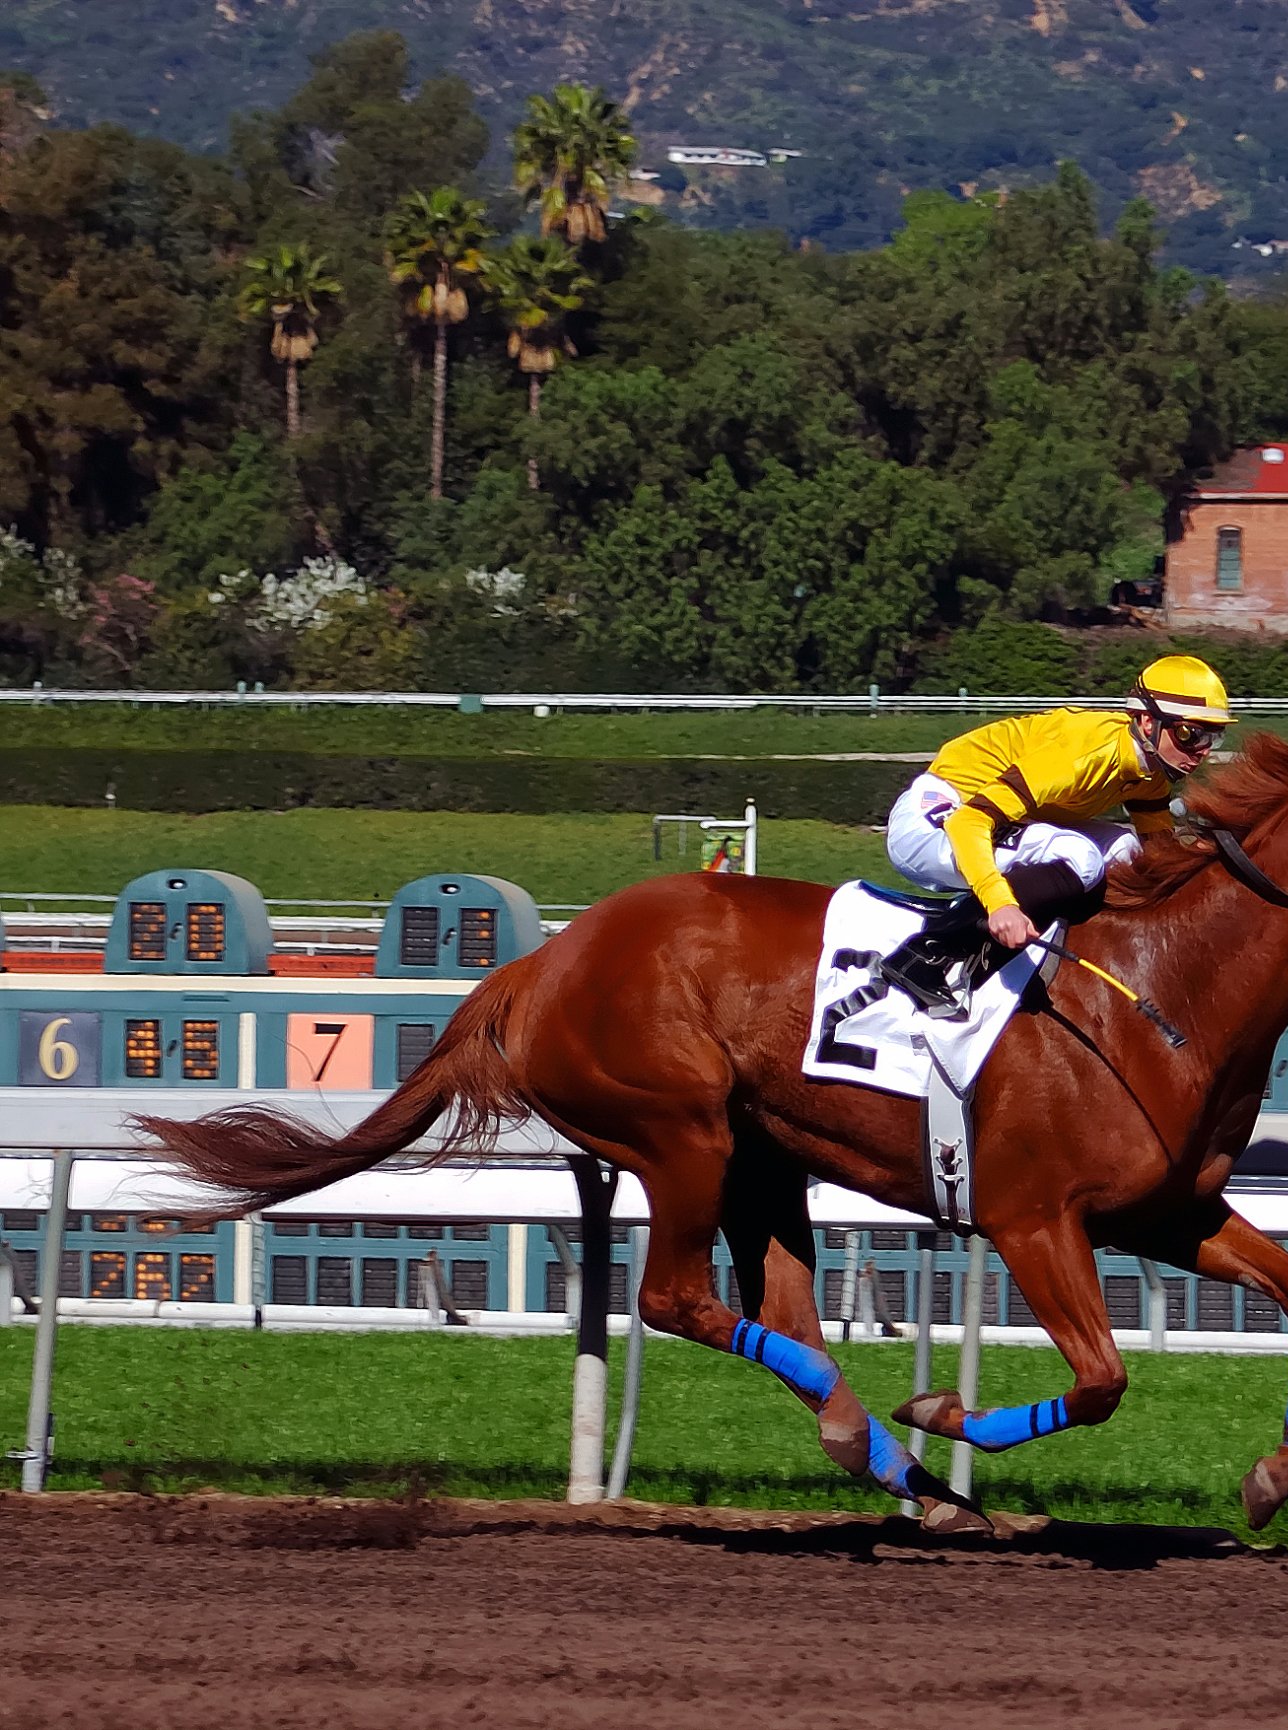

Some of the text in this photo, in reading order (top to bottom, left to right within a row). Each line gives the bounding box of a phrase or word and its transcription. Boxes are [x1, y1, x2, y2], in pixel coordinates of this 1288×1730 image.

[815, 948, 889, 1071] 2
[39, 1017, 79, 1080] 6
[314, 1022, 347, 1082] 7
